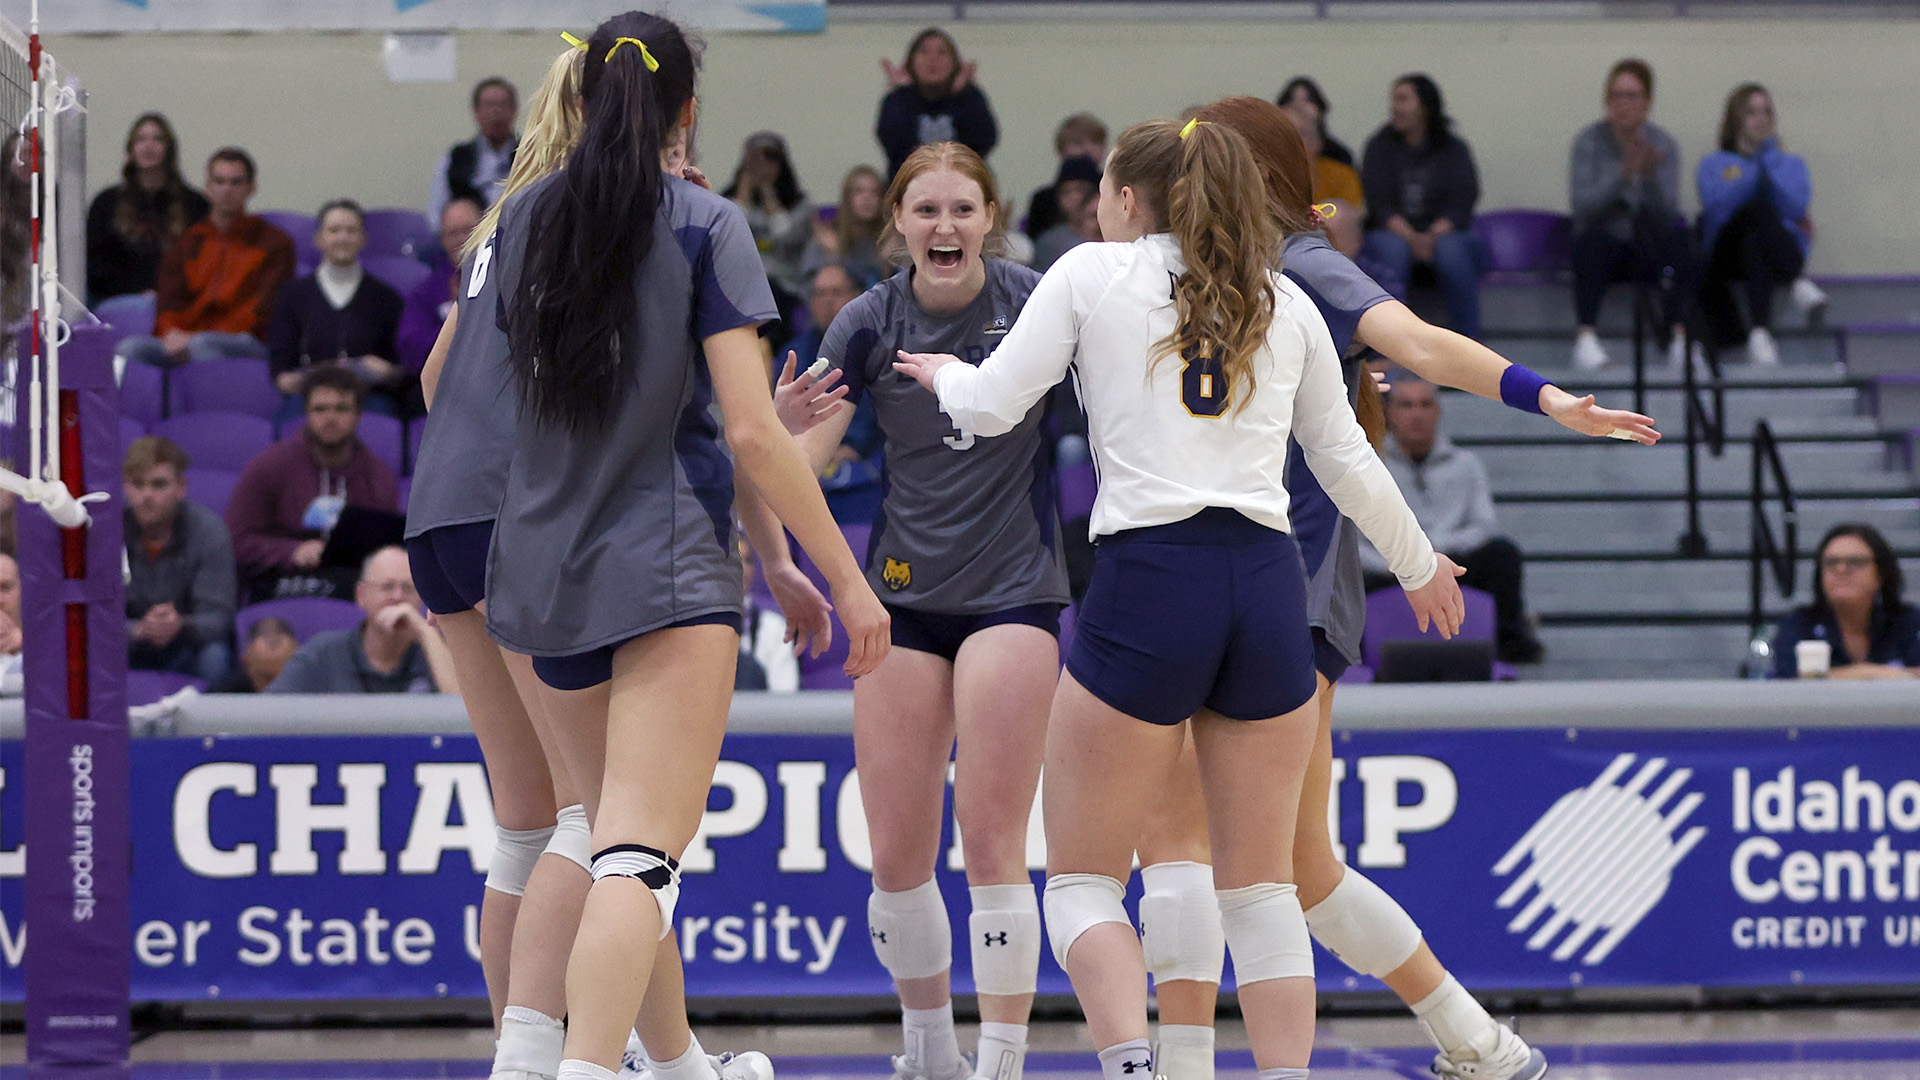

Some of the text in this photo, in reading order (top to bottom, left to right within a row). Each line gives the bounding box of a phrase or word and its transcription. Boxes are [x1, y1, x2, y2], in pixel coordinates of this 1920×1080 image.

[1178, 320, 1232, 419] 8
[1732, 765, 1920, 833] Idaho
[69, 744, 97, 923] sports imports
[237, 905, 437, 967] State
[1731, 916, 1868, 949] CREDIT
